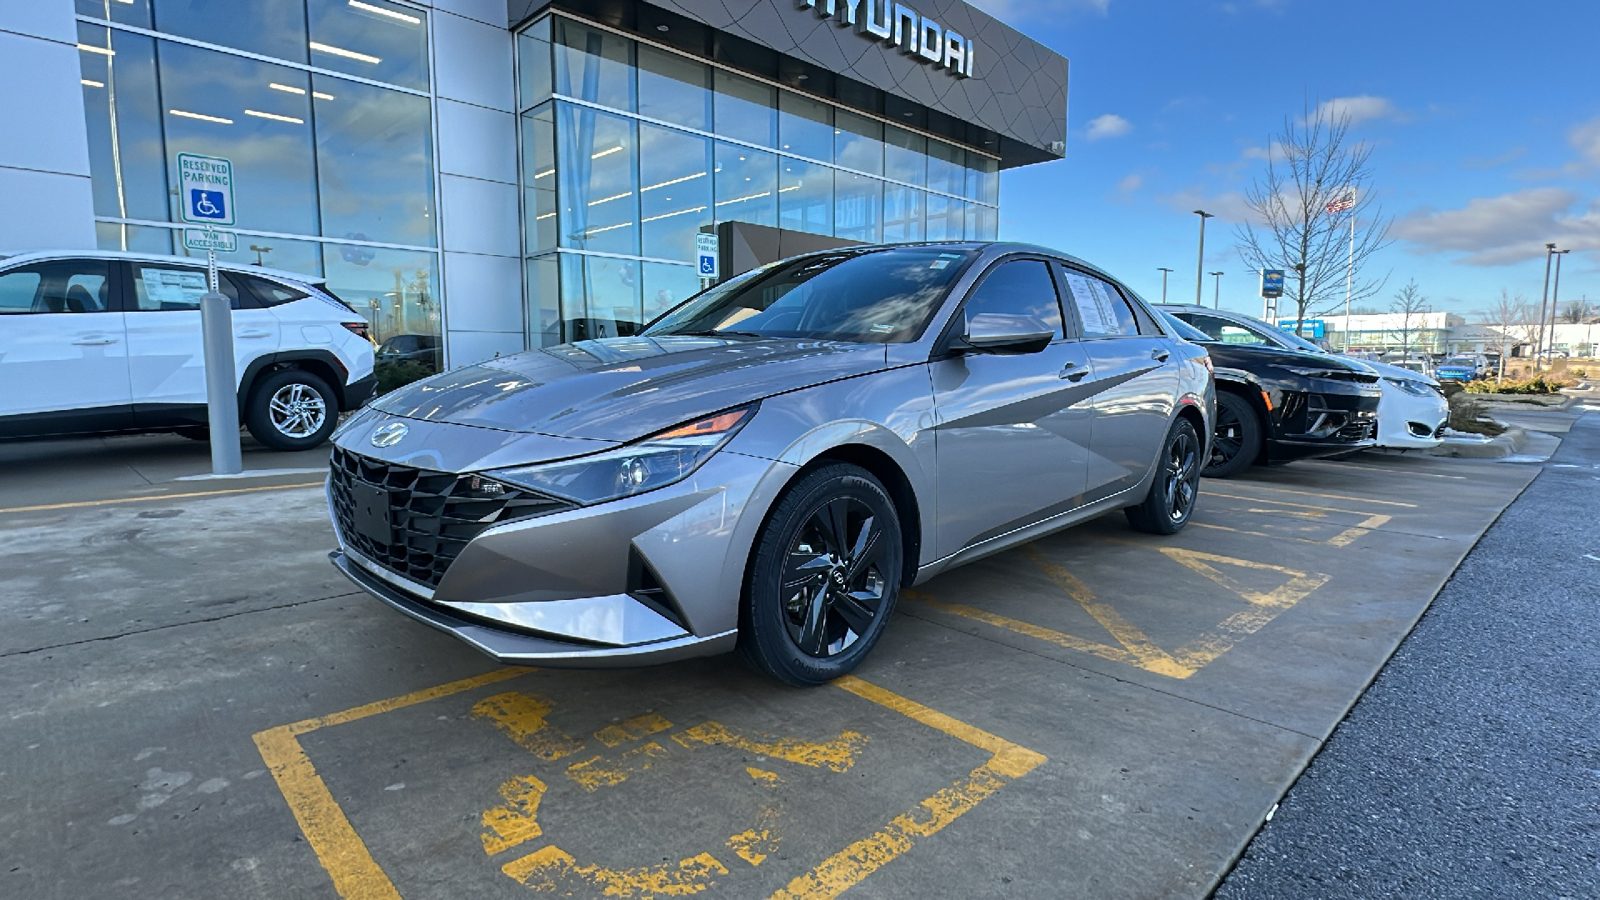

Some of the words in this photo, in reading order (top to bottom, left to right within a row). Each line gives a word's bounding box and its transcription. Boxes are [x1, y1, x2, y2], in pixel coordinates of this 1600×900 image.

[183, 160, 227, 174] RESERVED
[184, 172, 228, 185] PARKING
[203, 232, 219, 240] VAN
[188, 240, 233, 249] ACCESSIBLE
